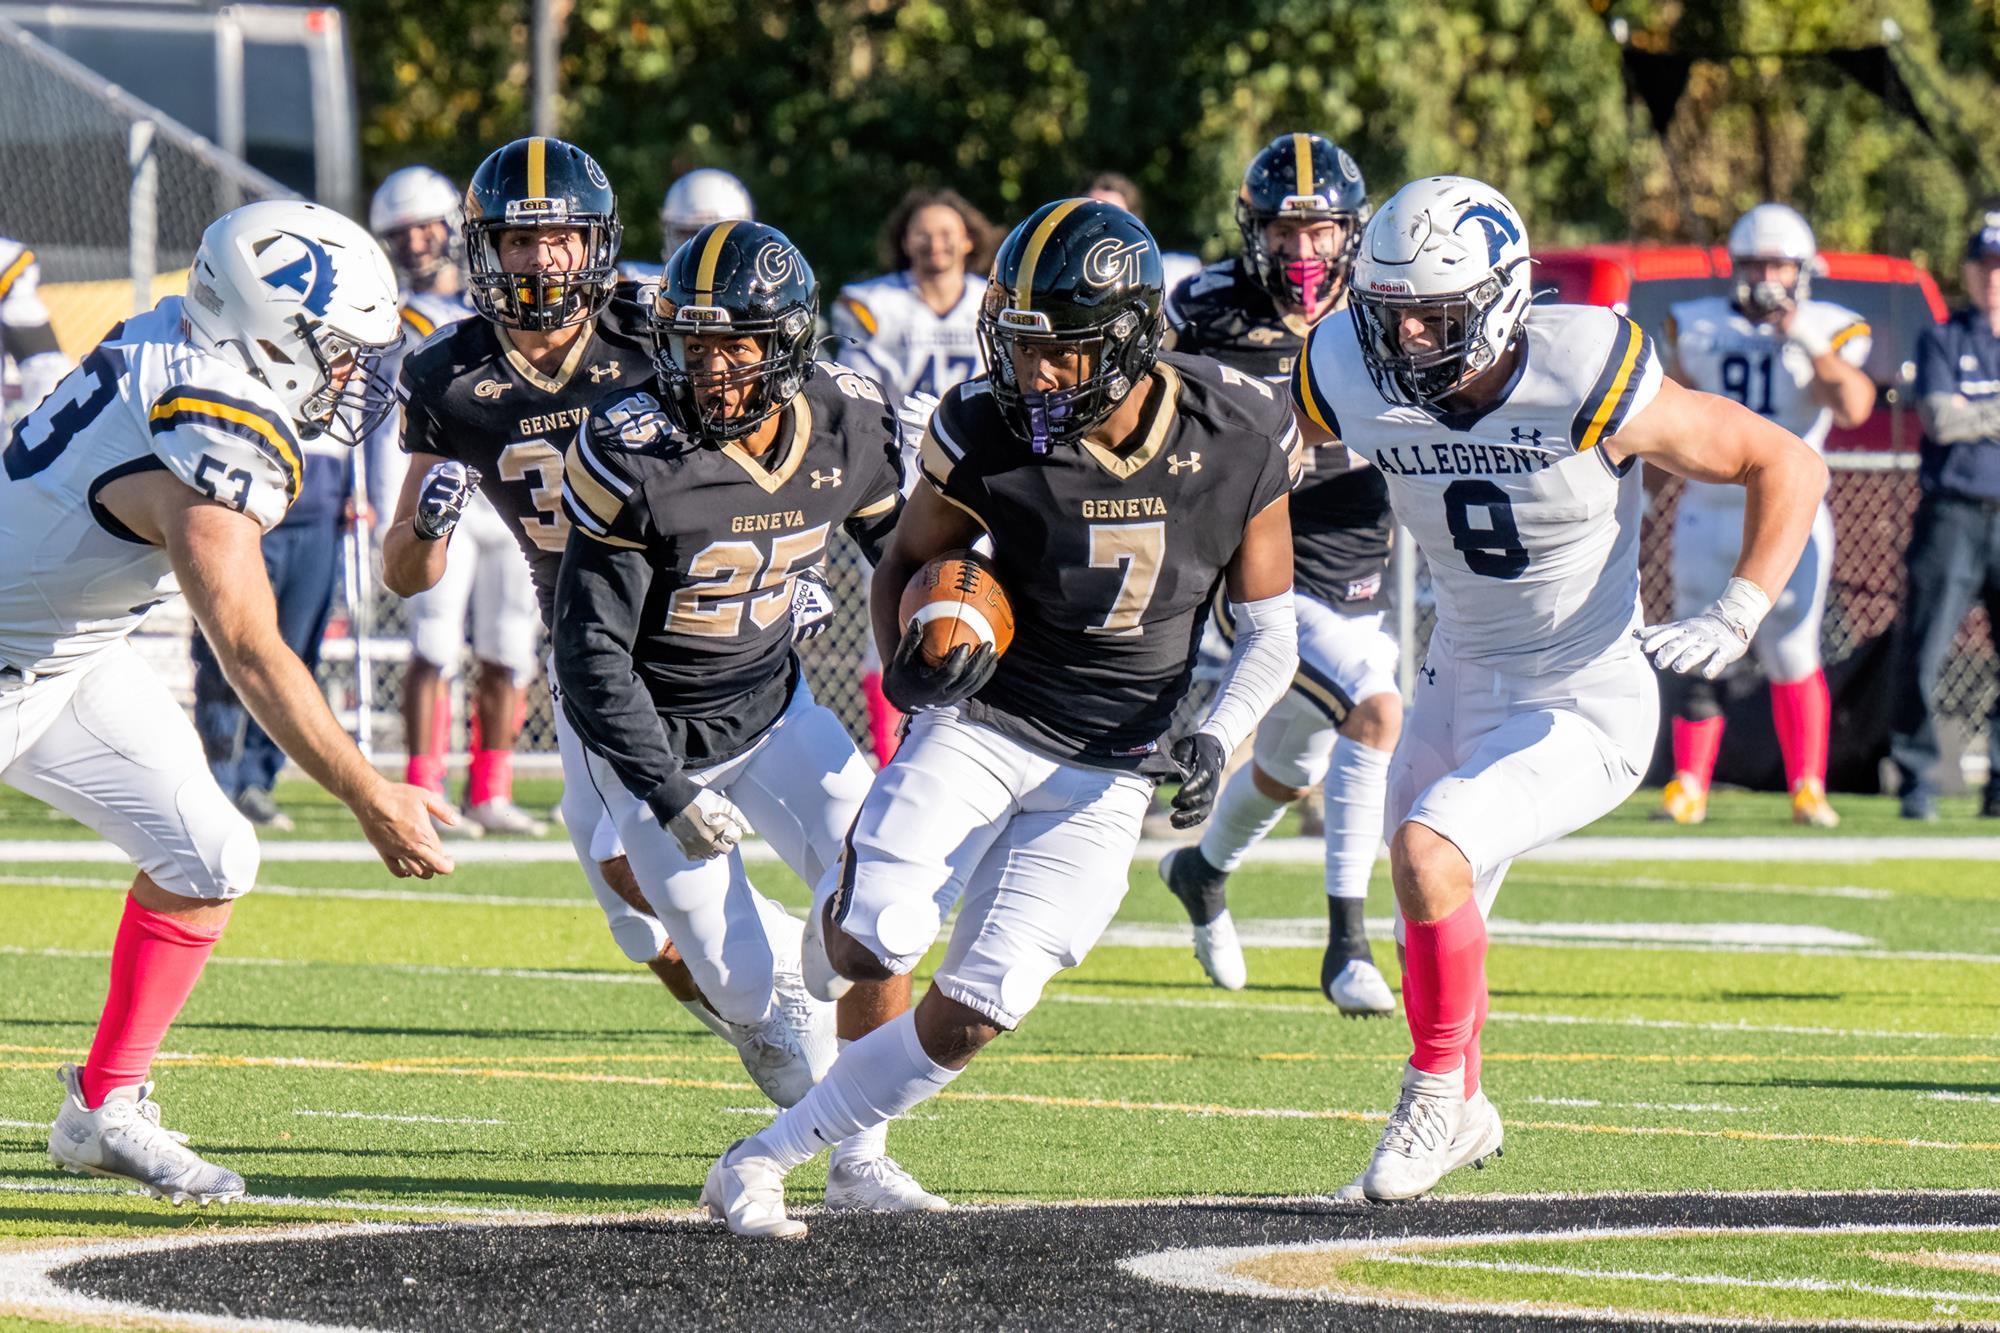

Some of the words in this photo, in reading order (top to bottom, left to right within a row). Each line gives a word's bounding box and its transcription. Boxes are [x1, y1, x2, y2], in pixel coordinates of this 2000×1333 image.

[755, 242, 805, 287] GT
[1083, 237, 1150, 290] GT
[1370, 281, 1407, 293] Riddell
[473, 379, 512, 399] GT
[1722, 354, 1776, 415] 91
[604, 391, 674, 450] 25
[194, 452, 253, 514] 53
[1376, 442, 1552, 476] ALLEGHENY
[731, 510, 805, 533] GENEVA
[1081, 496, 1168, 519] GENEVA
[1443, 479, 1531, 580] 8
[663, 520, 831, 638] 25
[1083, 520, 1166, 637] 7
